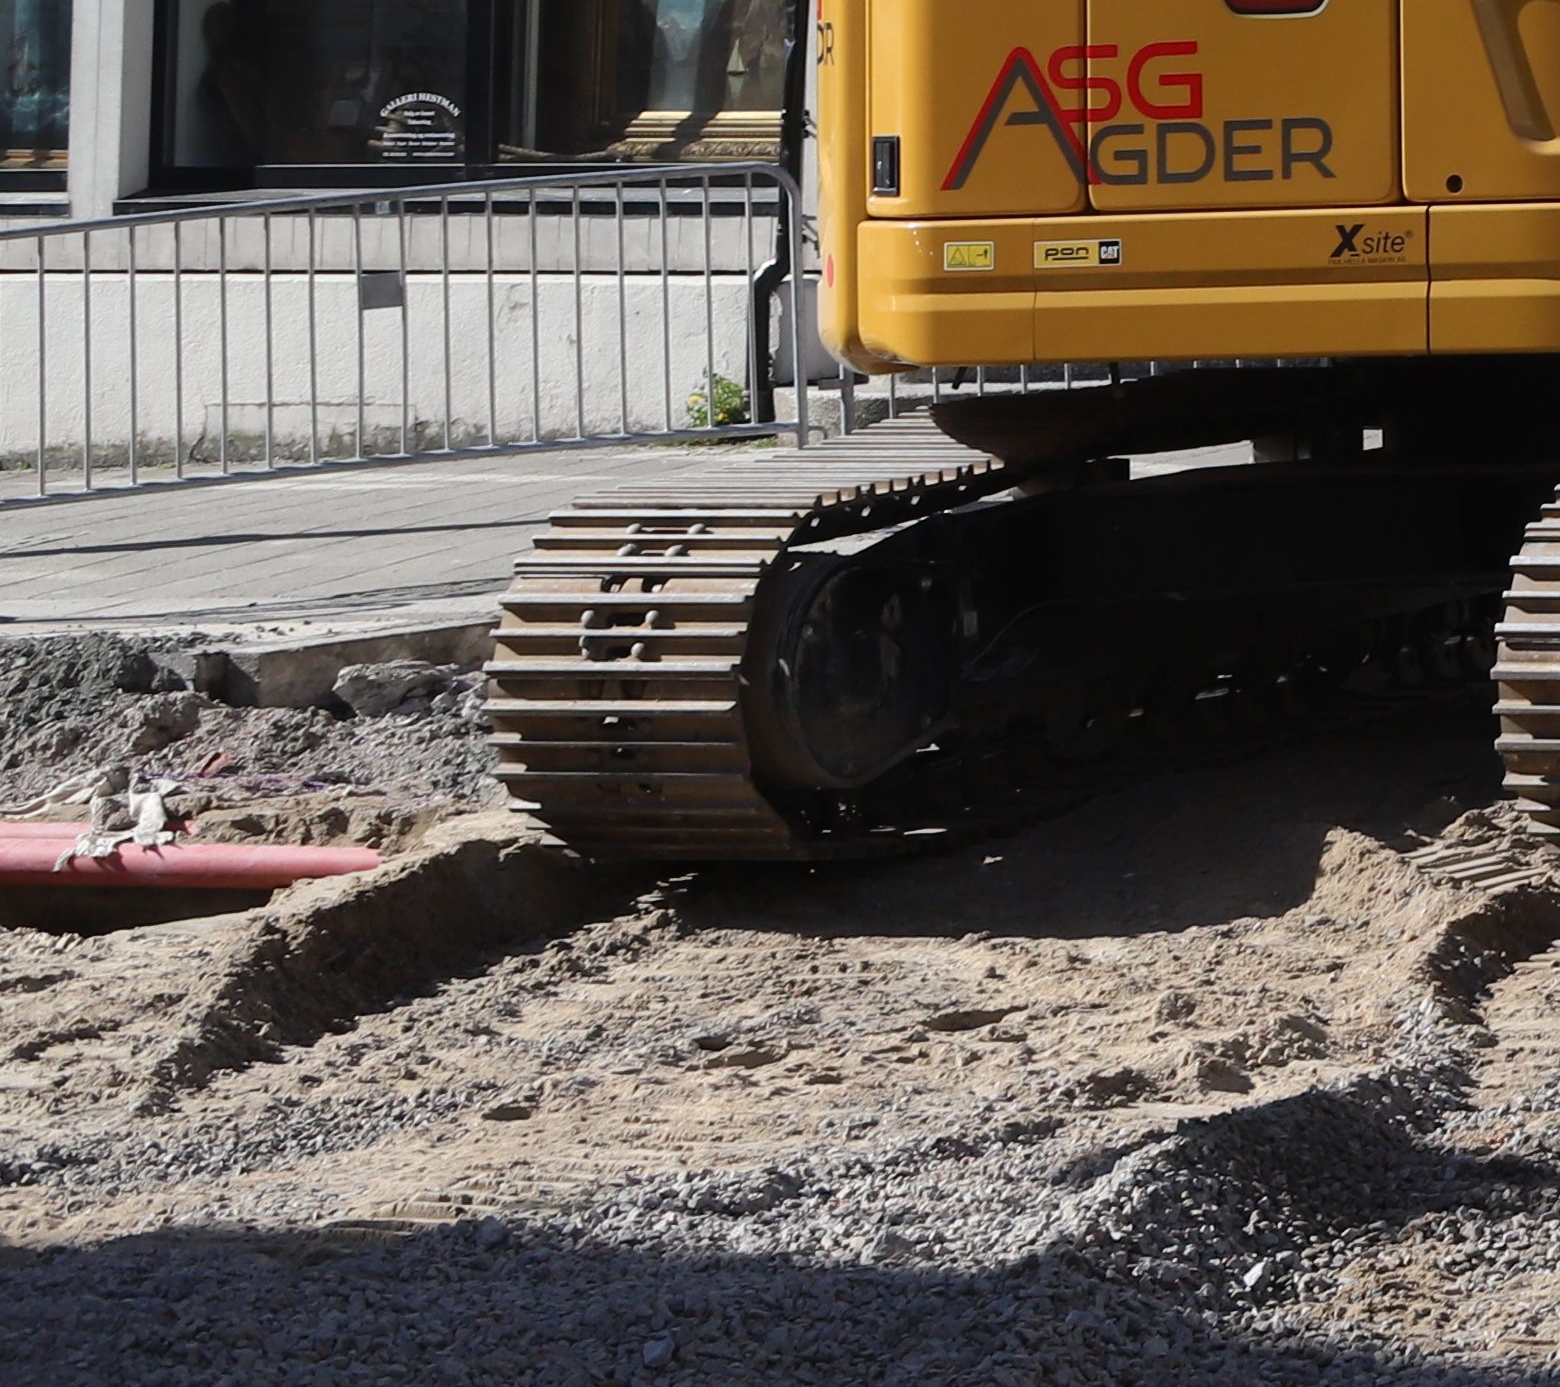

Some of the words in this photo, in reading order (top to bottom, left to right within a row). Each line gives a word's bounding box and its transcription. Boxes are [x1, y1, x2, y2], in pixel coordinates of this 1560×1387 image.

[940, 41, 1203, 190] ASG
[1045, 247, 1089, 260] pon
[1101, 245, 1119, 260] CAT
